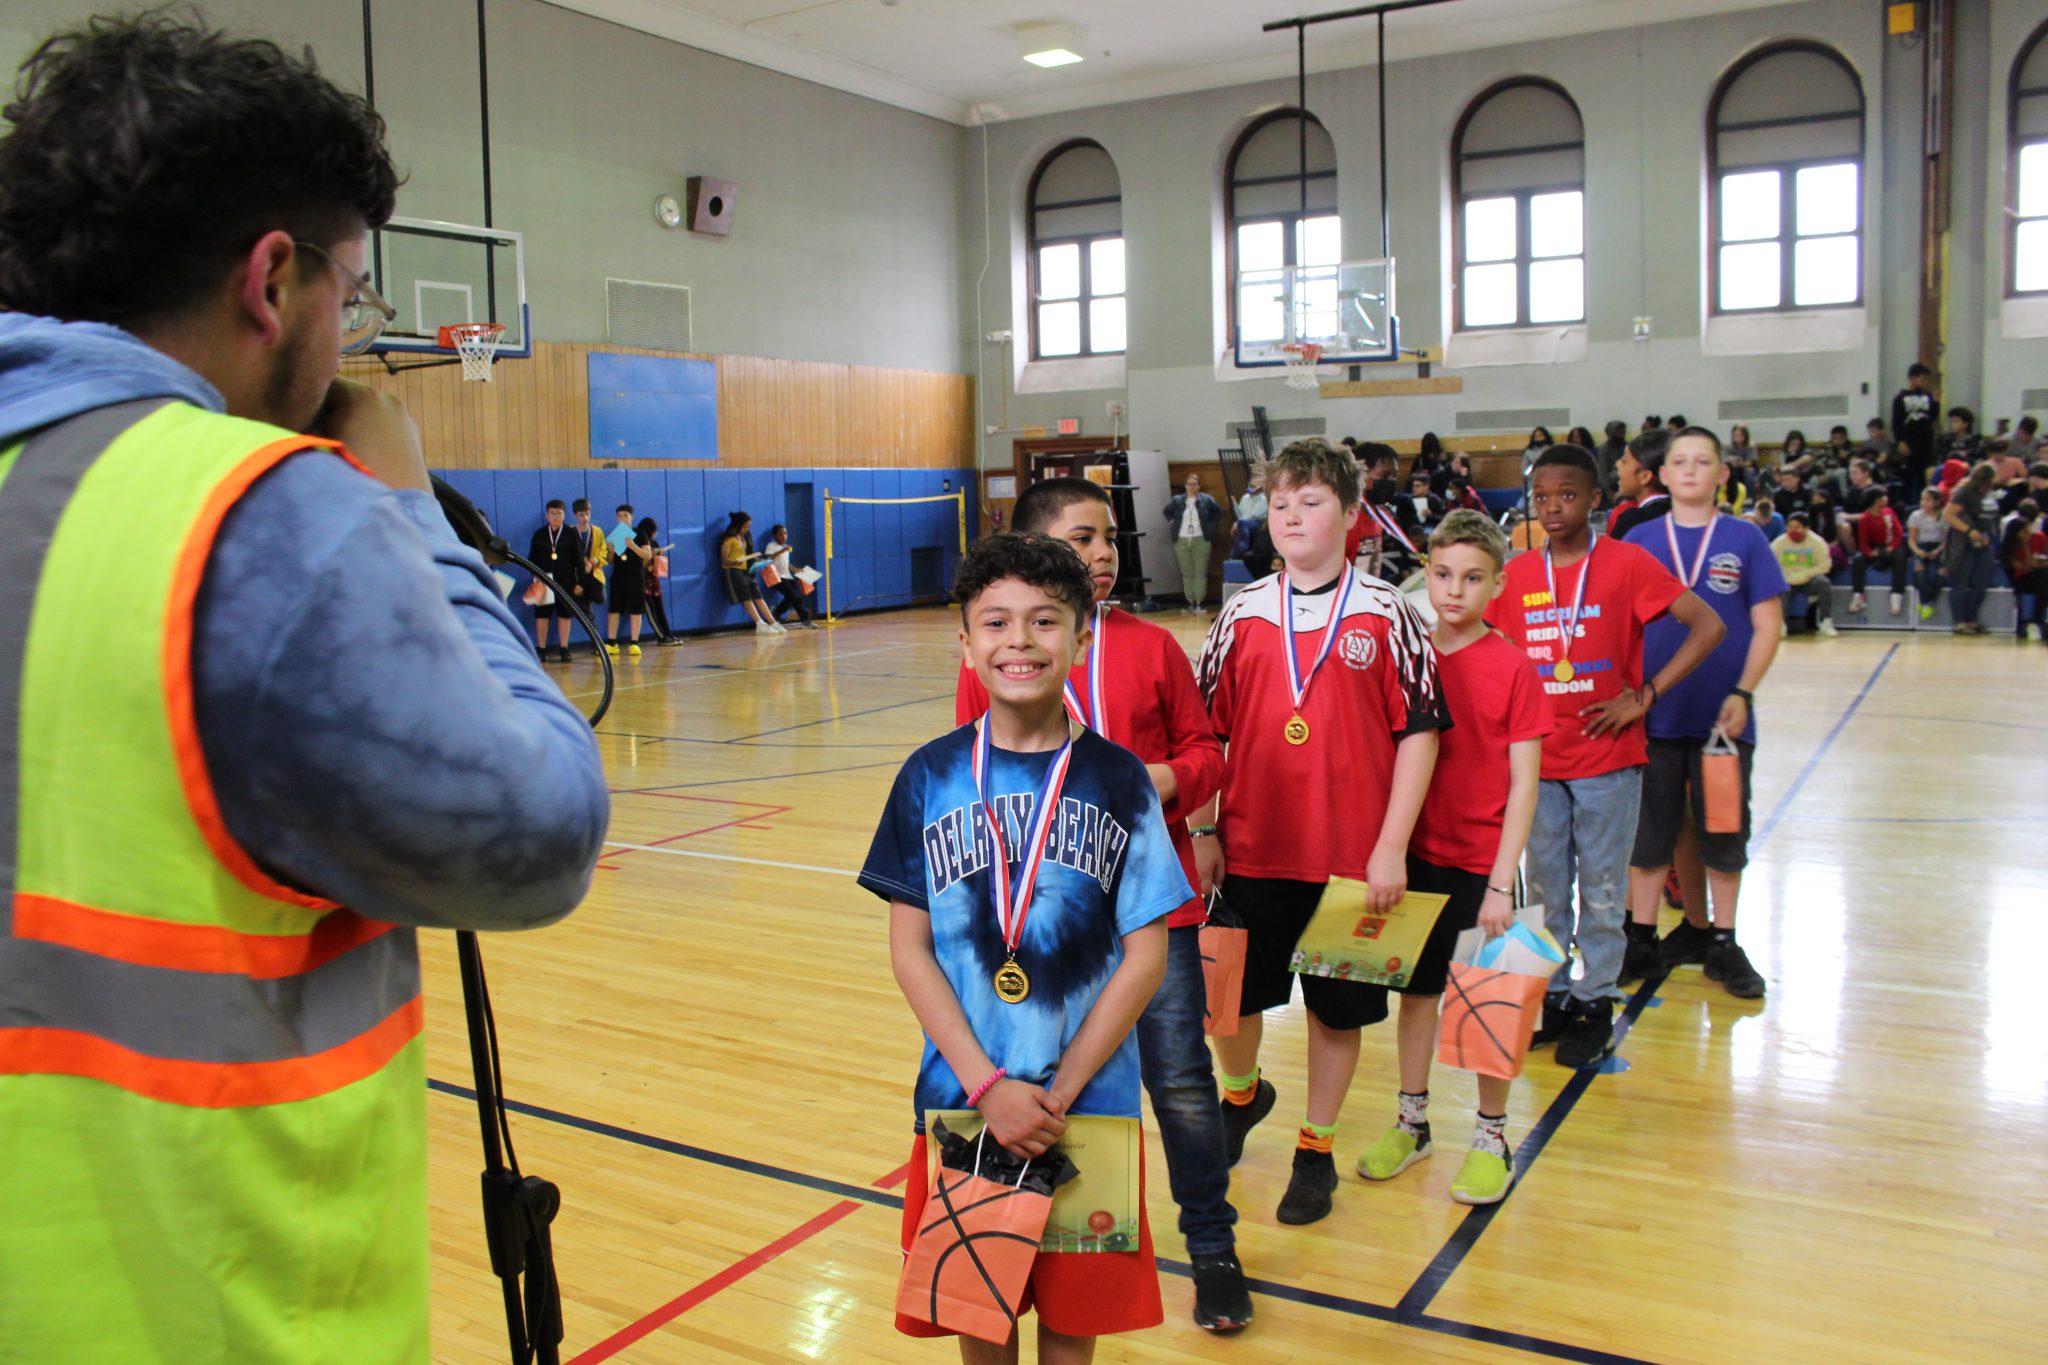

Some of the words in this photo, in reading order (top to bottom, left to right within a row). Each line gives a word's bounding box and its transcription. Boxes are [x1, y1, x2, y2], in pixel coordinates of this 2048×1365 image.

[1522, 591, 1552, 607] SUN
[1525, 610, 1546, 624] ICE
[1526, 624, 1586, 642] FRIENS
[923, 792, 1034, 897] DELRAY
[1043, 796, 1129, 895] BEACH
